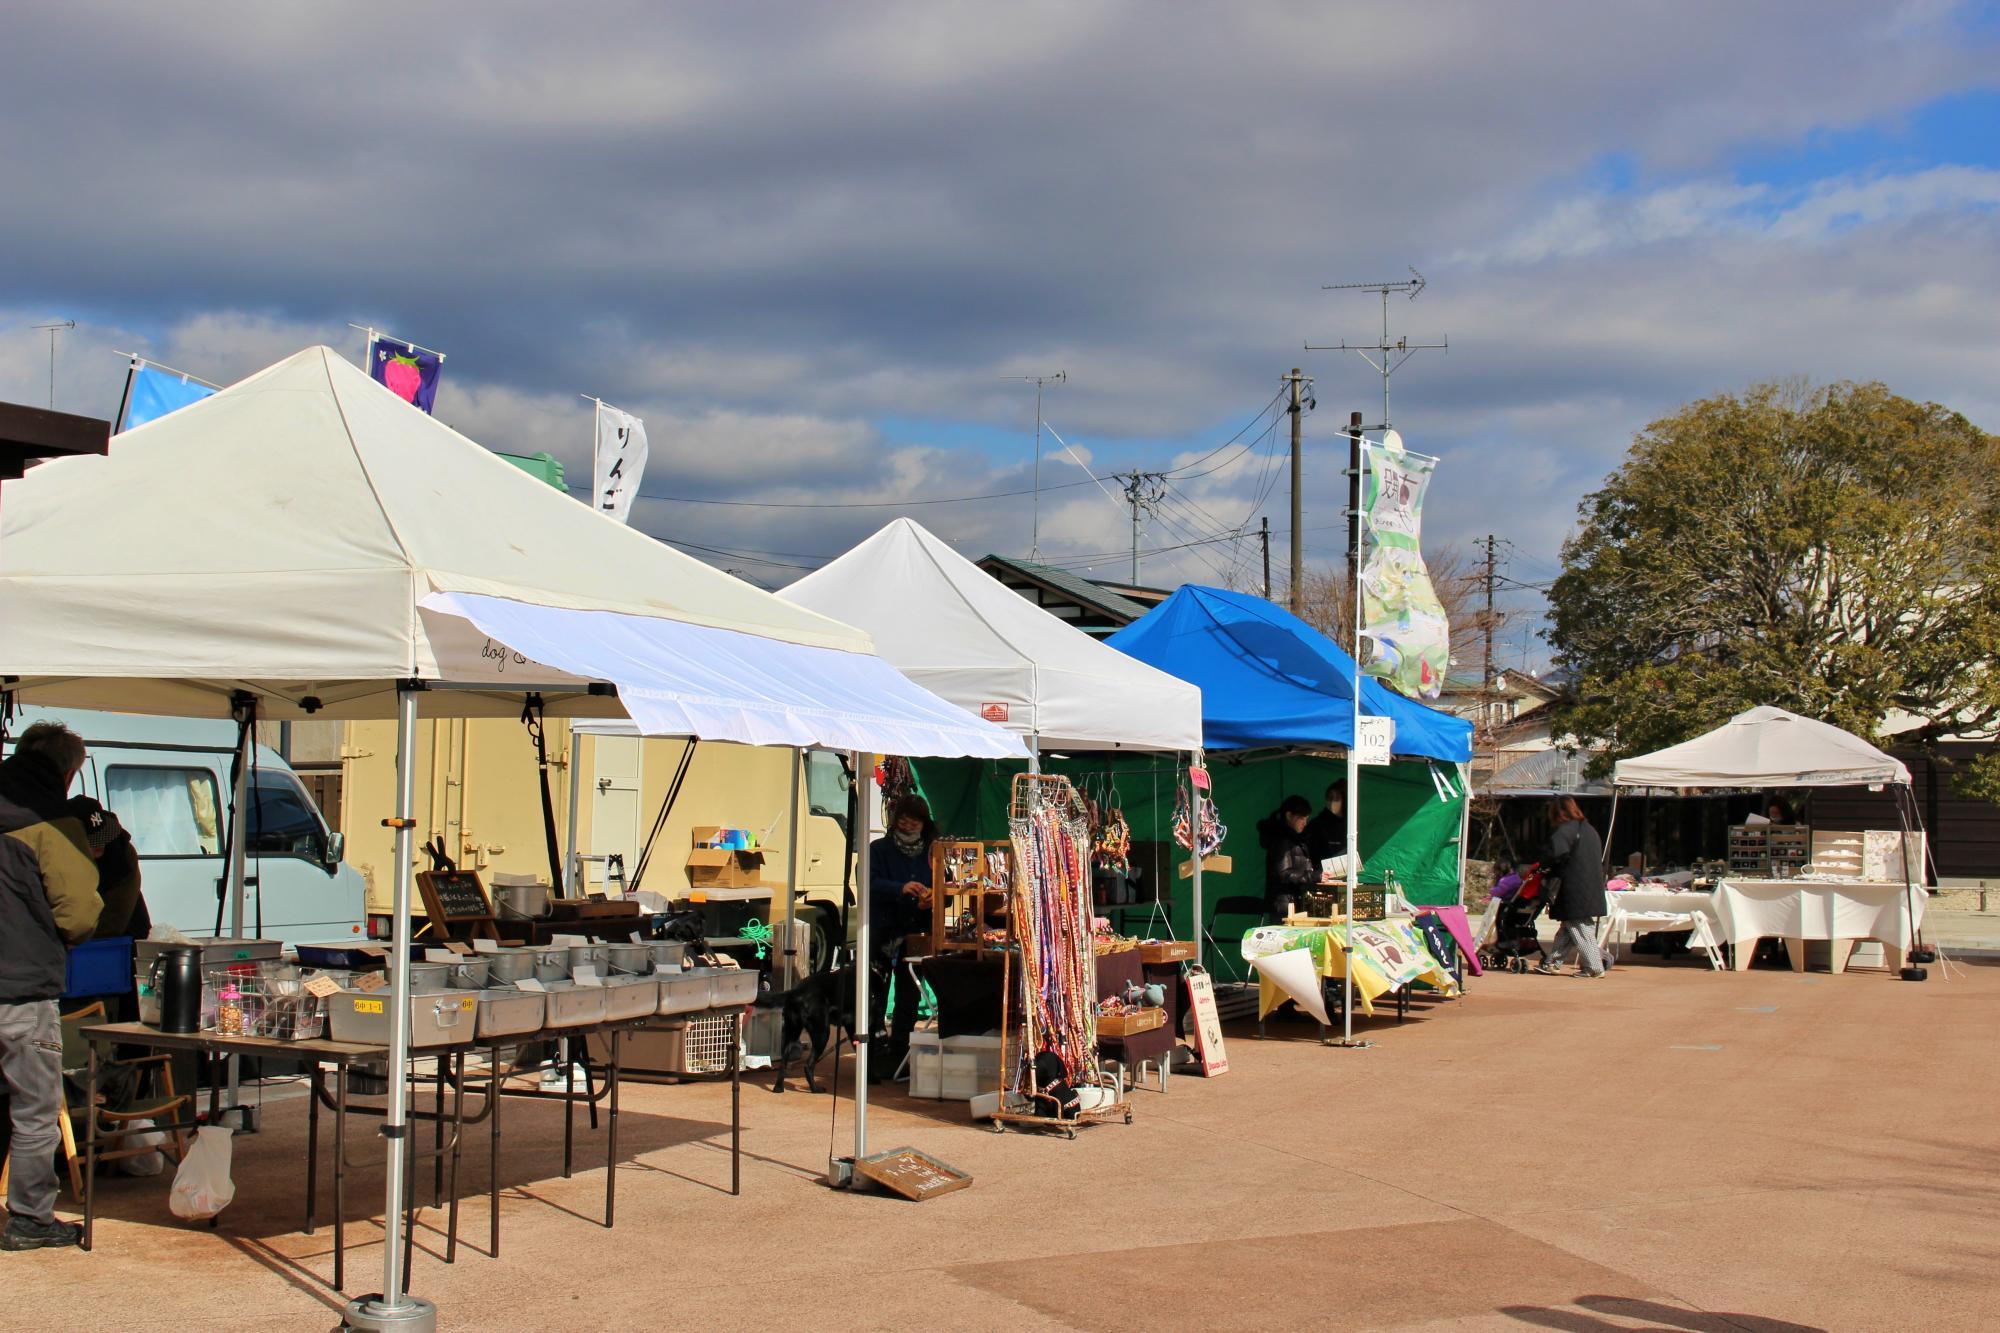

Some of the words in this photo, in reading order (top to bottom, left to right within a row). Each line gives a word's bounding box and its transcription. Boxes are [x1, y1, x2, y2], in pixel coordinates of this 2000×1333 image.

[602, 426, 630, 510] りんご
[481, 638, 507, 673] dog
[513, 651, 527, 665] &
[1363, 734, 1385, 747] 102
